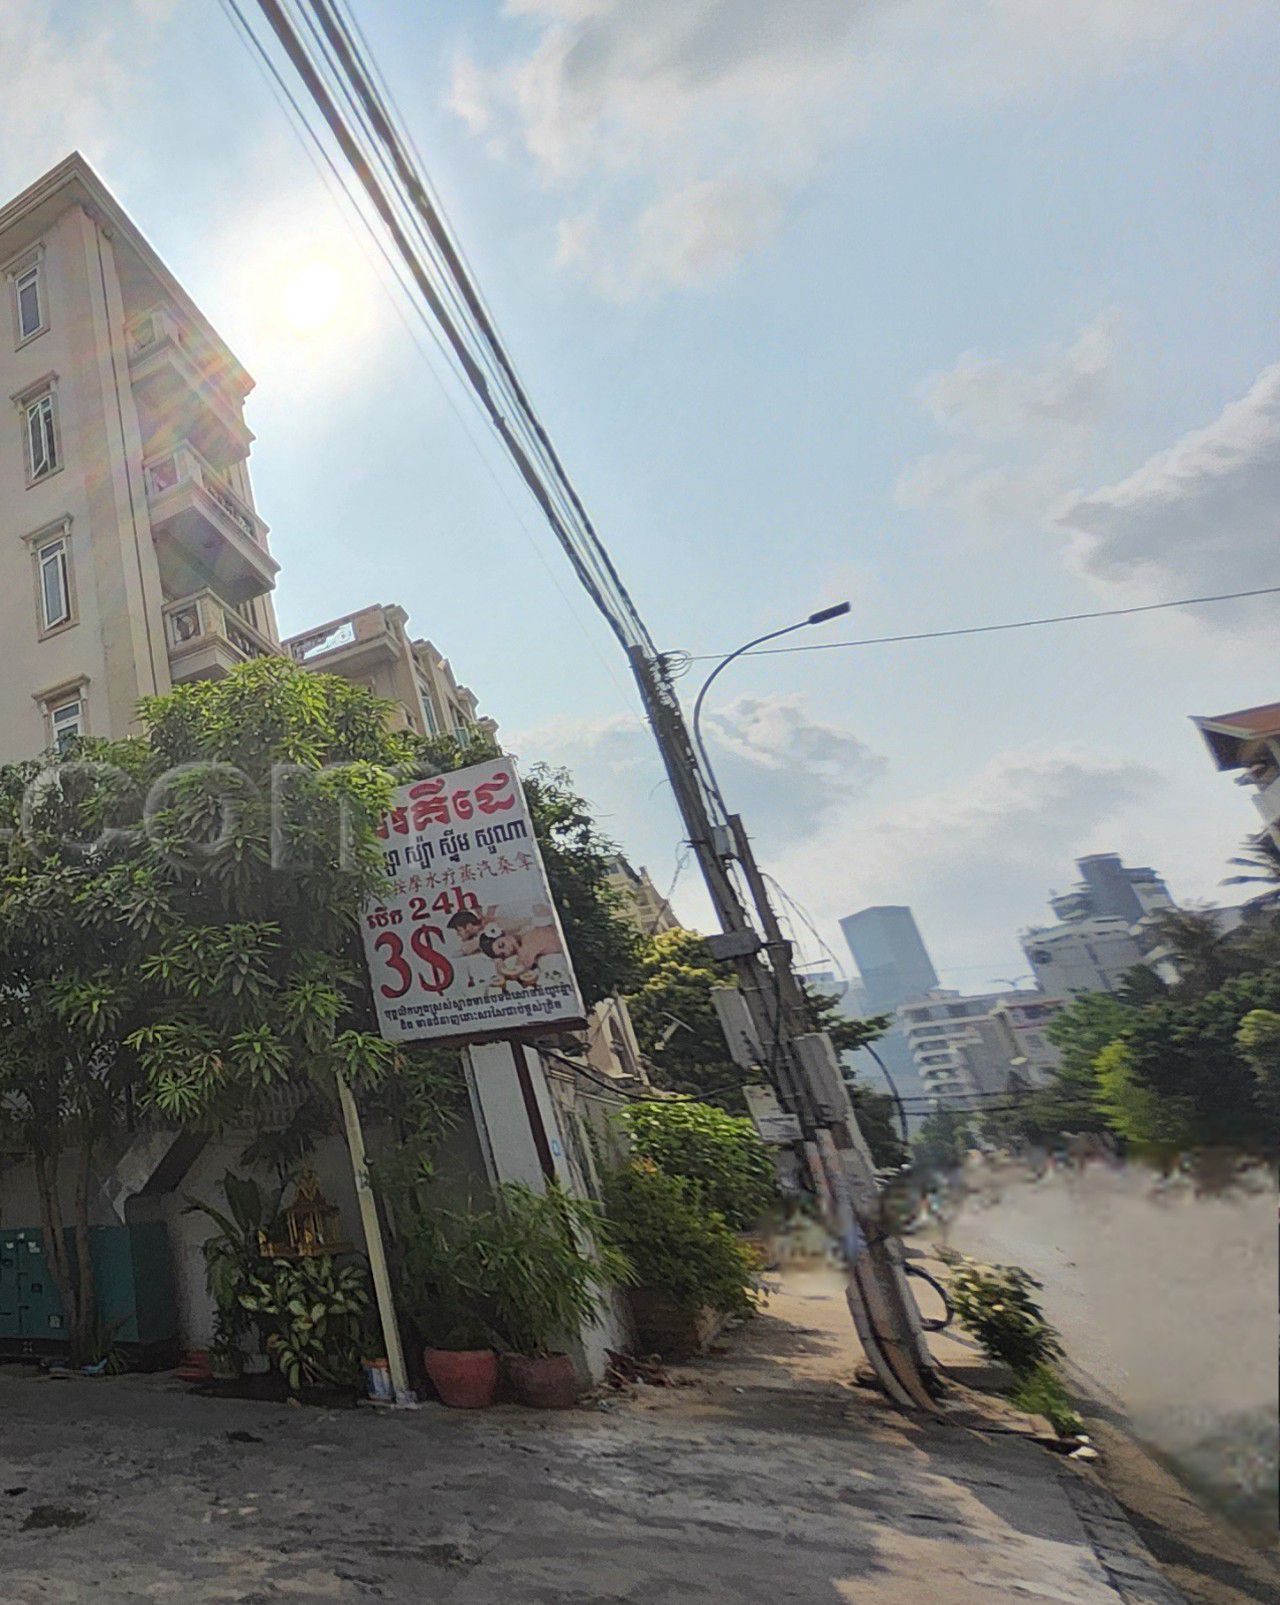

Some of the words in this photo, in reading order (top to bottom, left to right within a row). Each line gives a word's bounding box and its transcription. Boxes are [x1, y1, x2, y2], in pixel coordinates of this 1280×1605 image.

[475, 820, 528, 855] សូណា
[408, 886, 481, 921] 24h
[374, 924, 455, 998] 3$
